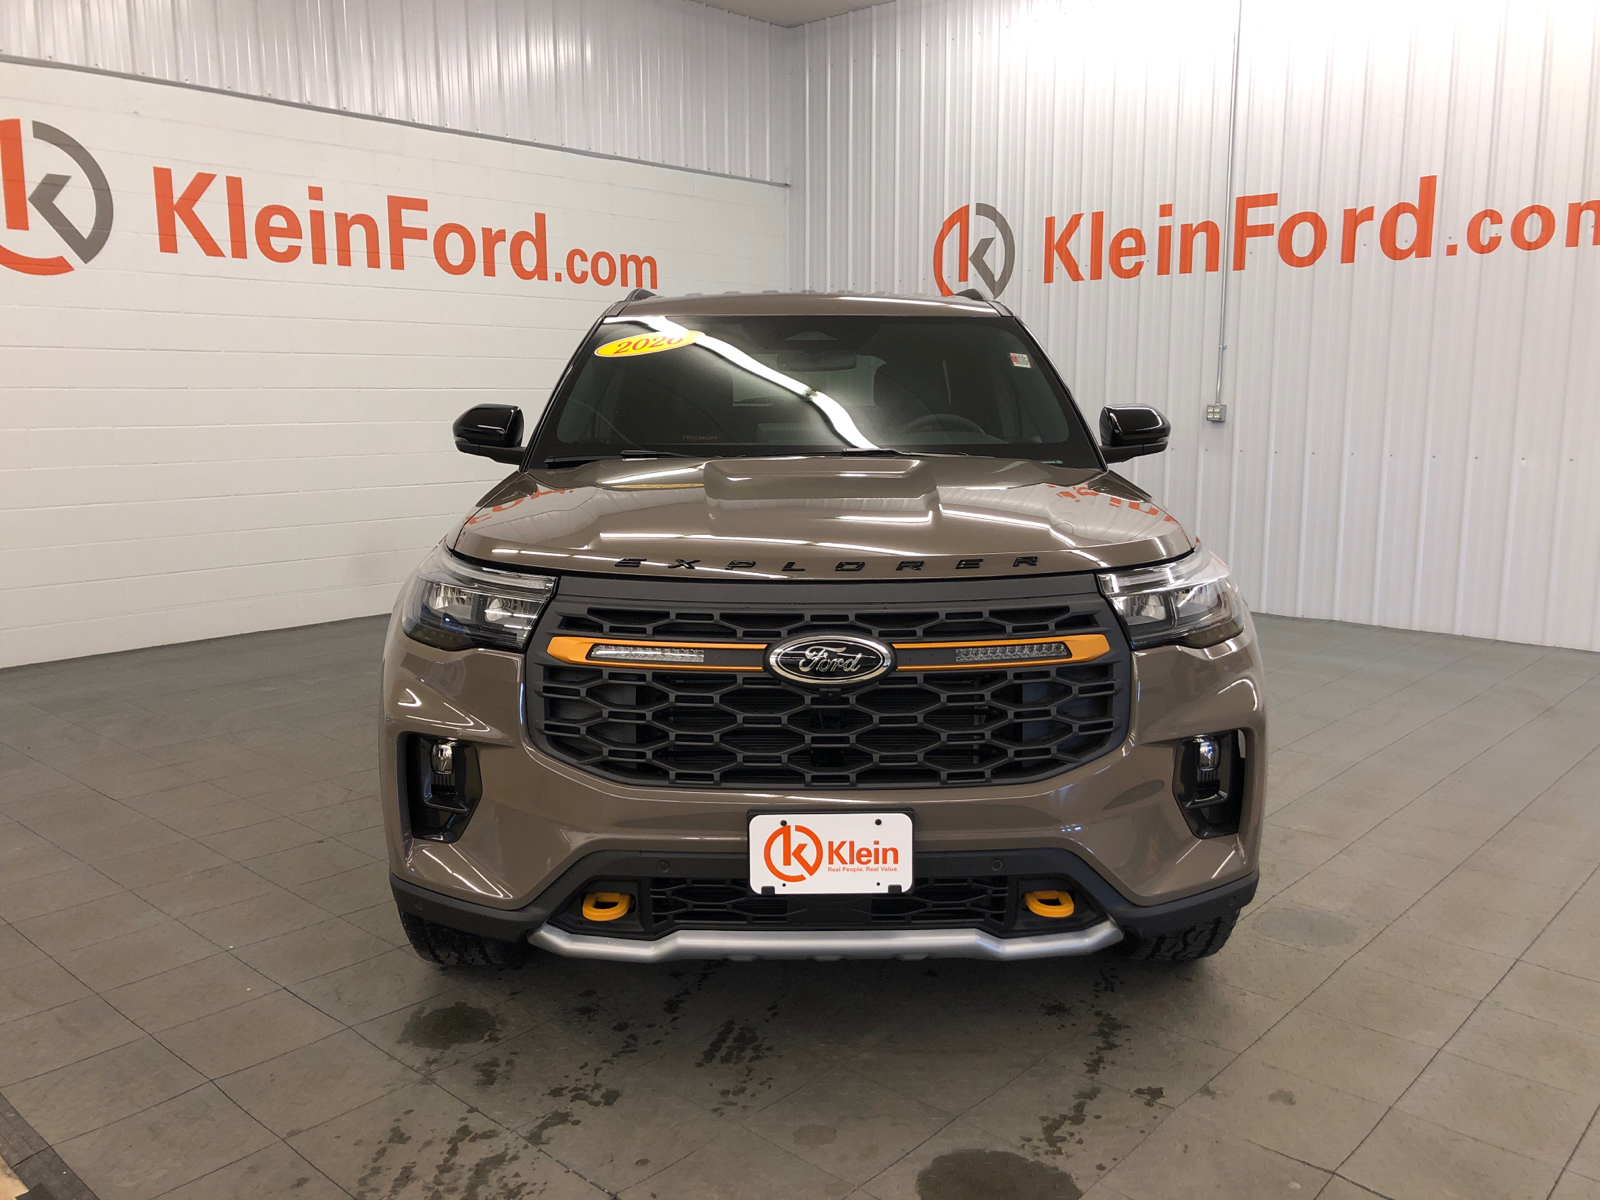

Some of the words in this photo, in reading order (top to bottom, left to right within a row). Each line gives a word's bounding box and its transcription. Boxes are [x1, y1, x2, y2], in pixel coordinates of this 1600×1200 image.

[152, 165, 658, 290] KleinFord.com
[614, 556, 1039, 572] EXPLORER
[798, 645, 862, 672] Ford
[827, 840, 899, 866] Klein
